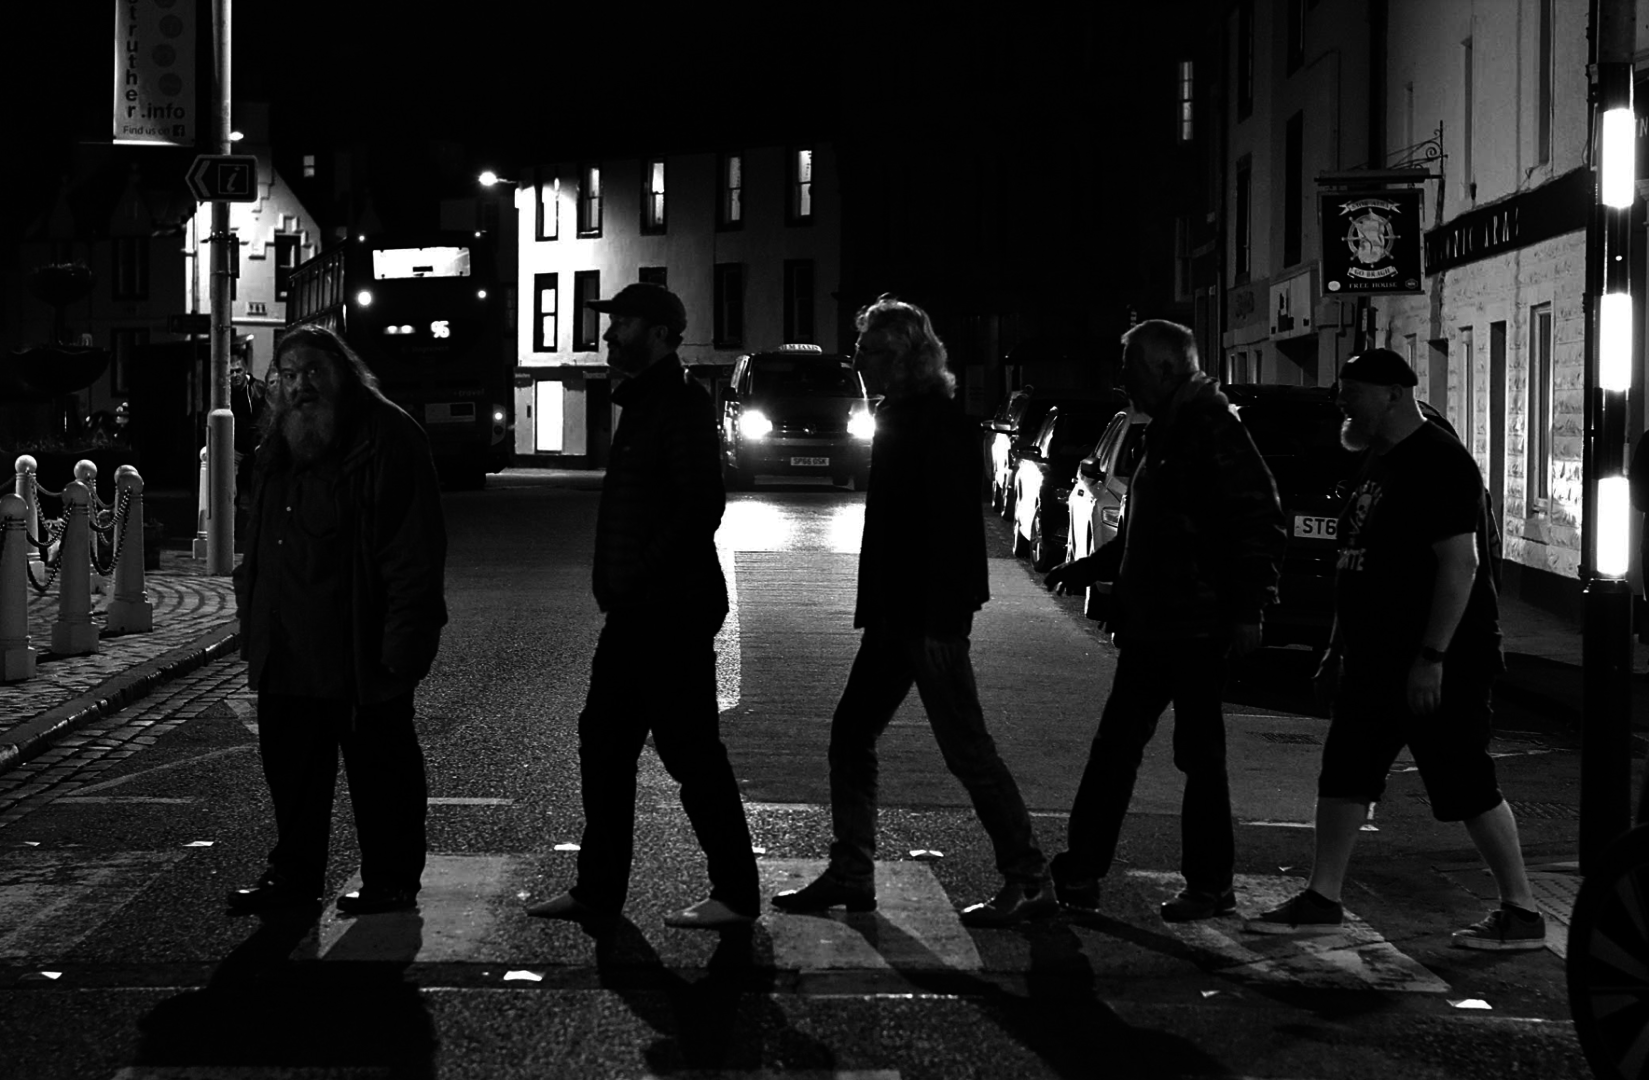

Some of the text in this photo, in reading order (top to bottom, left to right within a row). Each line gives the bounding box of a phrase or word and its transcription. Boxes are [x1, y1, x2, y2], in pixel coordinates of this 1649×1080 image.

[125, 0, 138, 118] truther
[141, 103, 185, 119] .info
[123, 125, 144, 135] Find
[146, 127, 156, 135] us
[158, 127, 170, 135] on
[1425, 226, 1473, 268] MONIC
